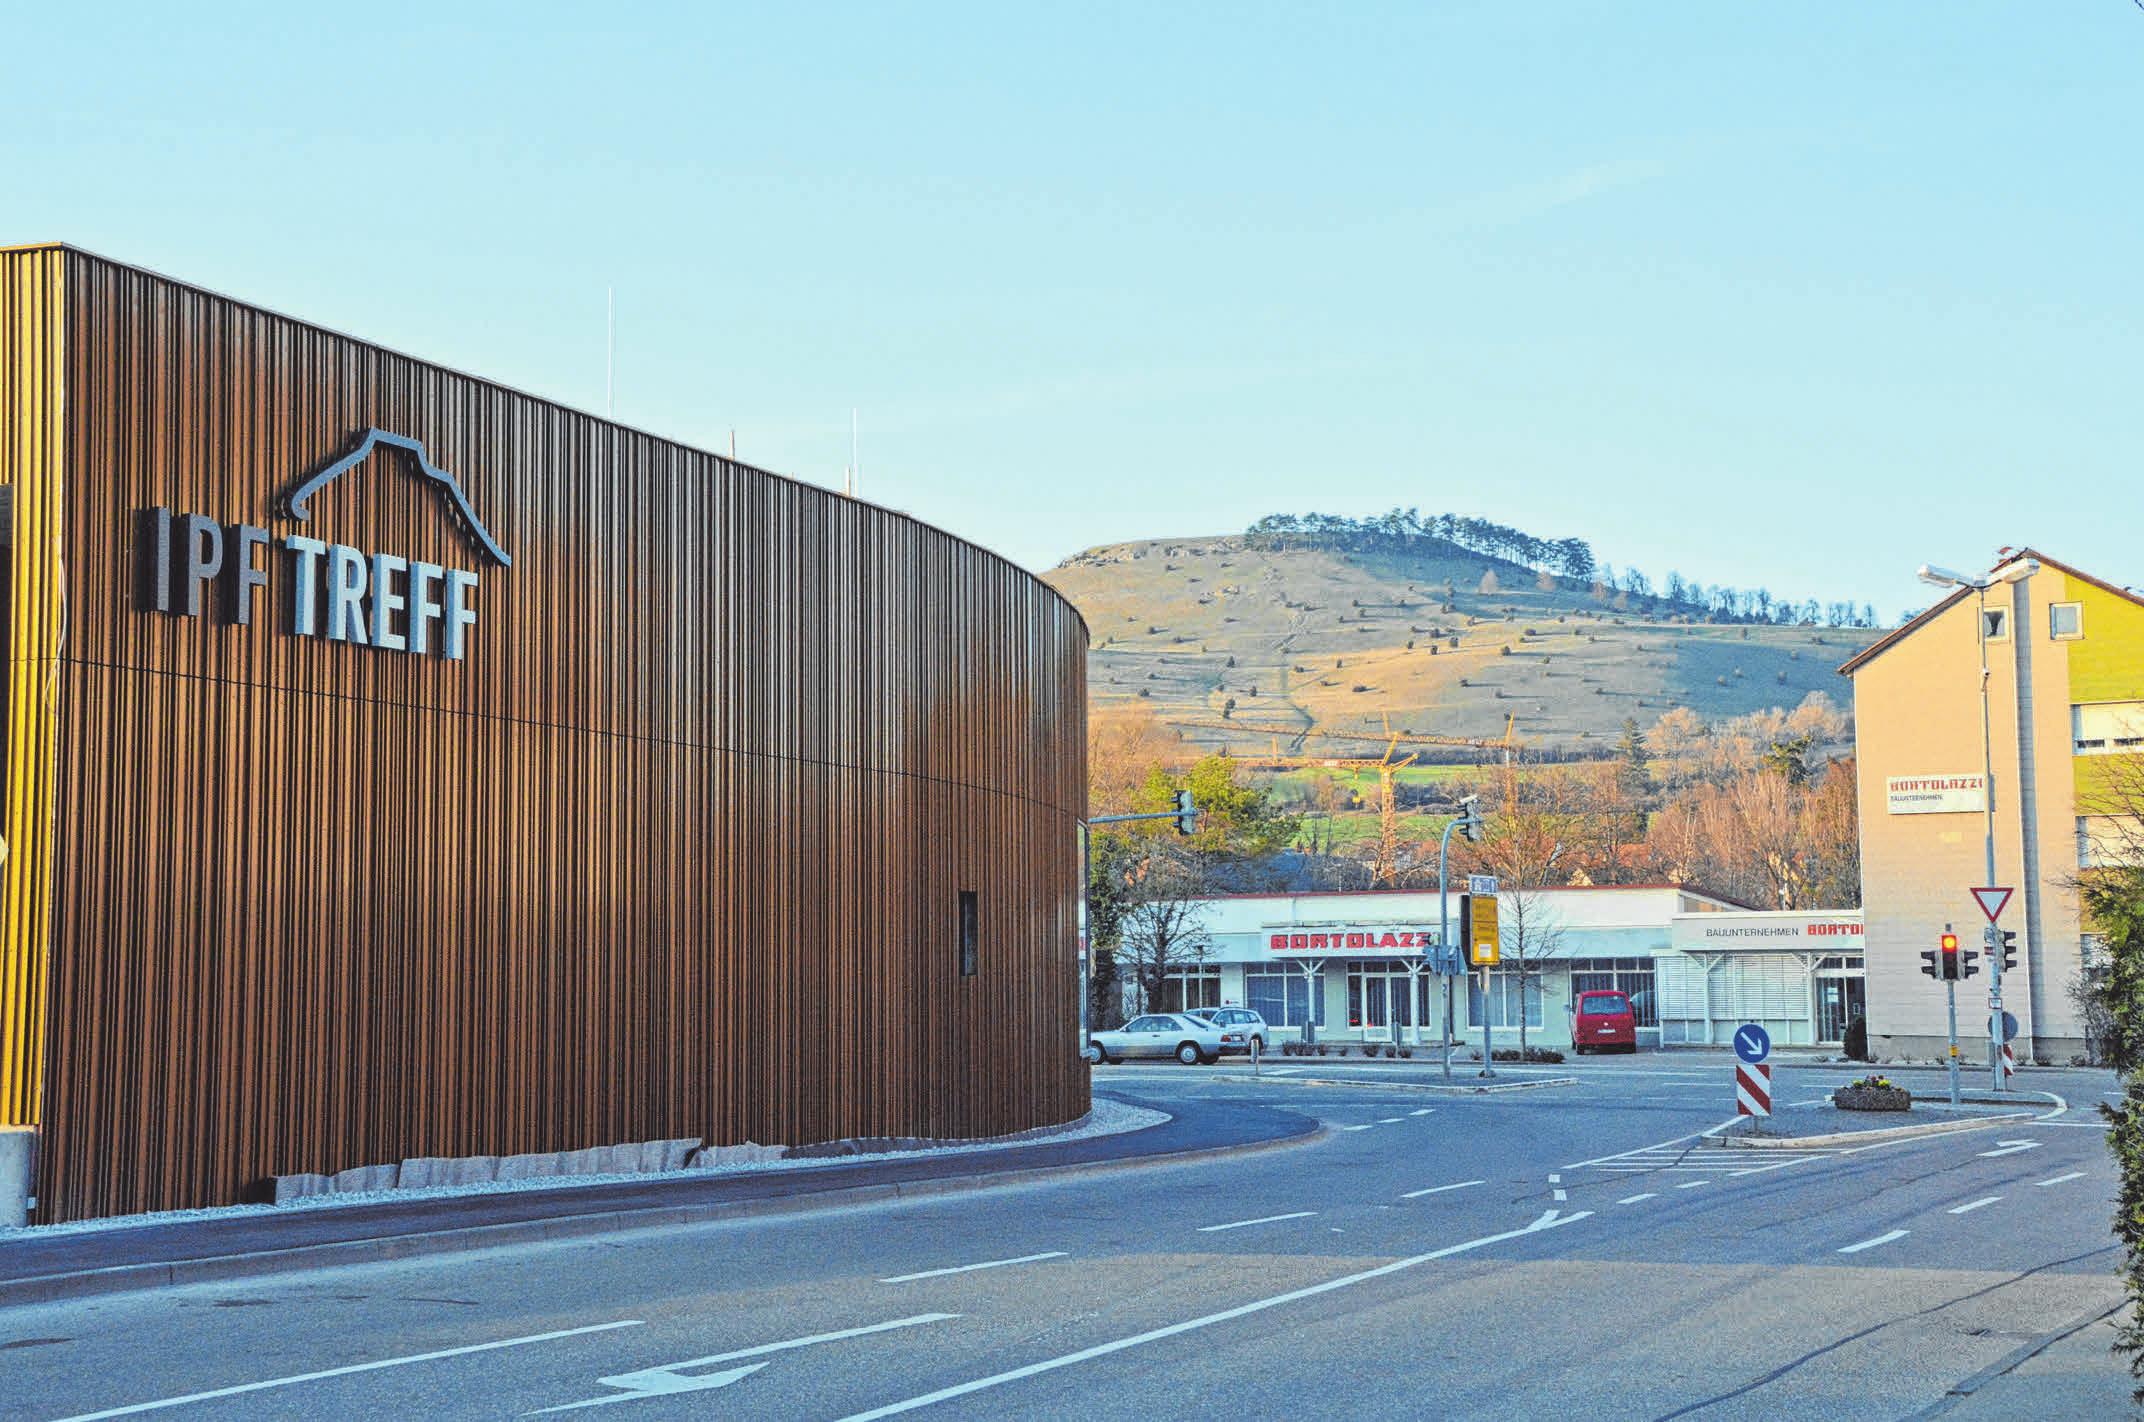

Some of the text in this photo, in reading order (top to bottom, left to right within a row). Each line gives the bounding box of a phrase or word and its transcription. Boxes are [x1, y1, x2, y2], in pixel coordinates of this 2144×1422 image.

[287, 534, 479, 660] TREFF
[1890, 777, 1983, 792] BORTOLAZZI
[1705, 923, 1865, 937] BAUUNTERNEHMEN BORTO
